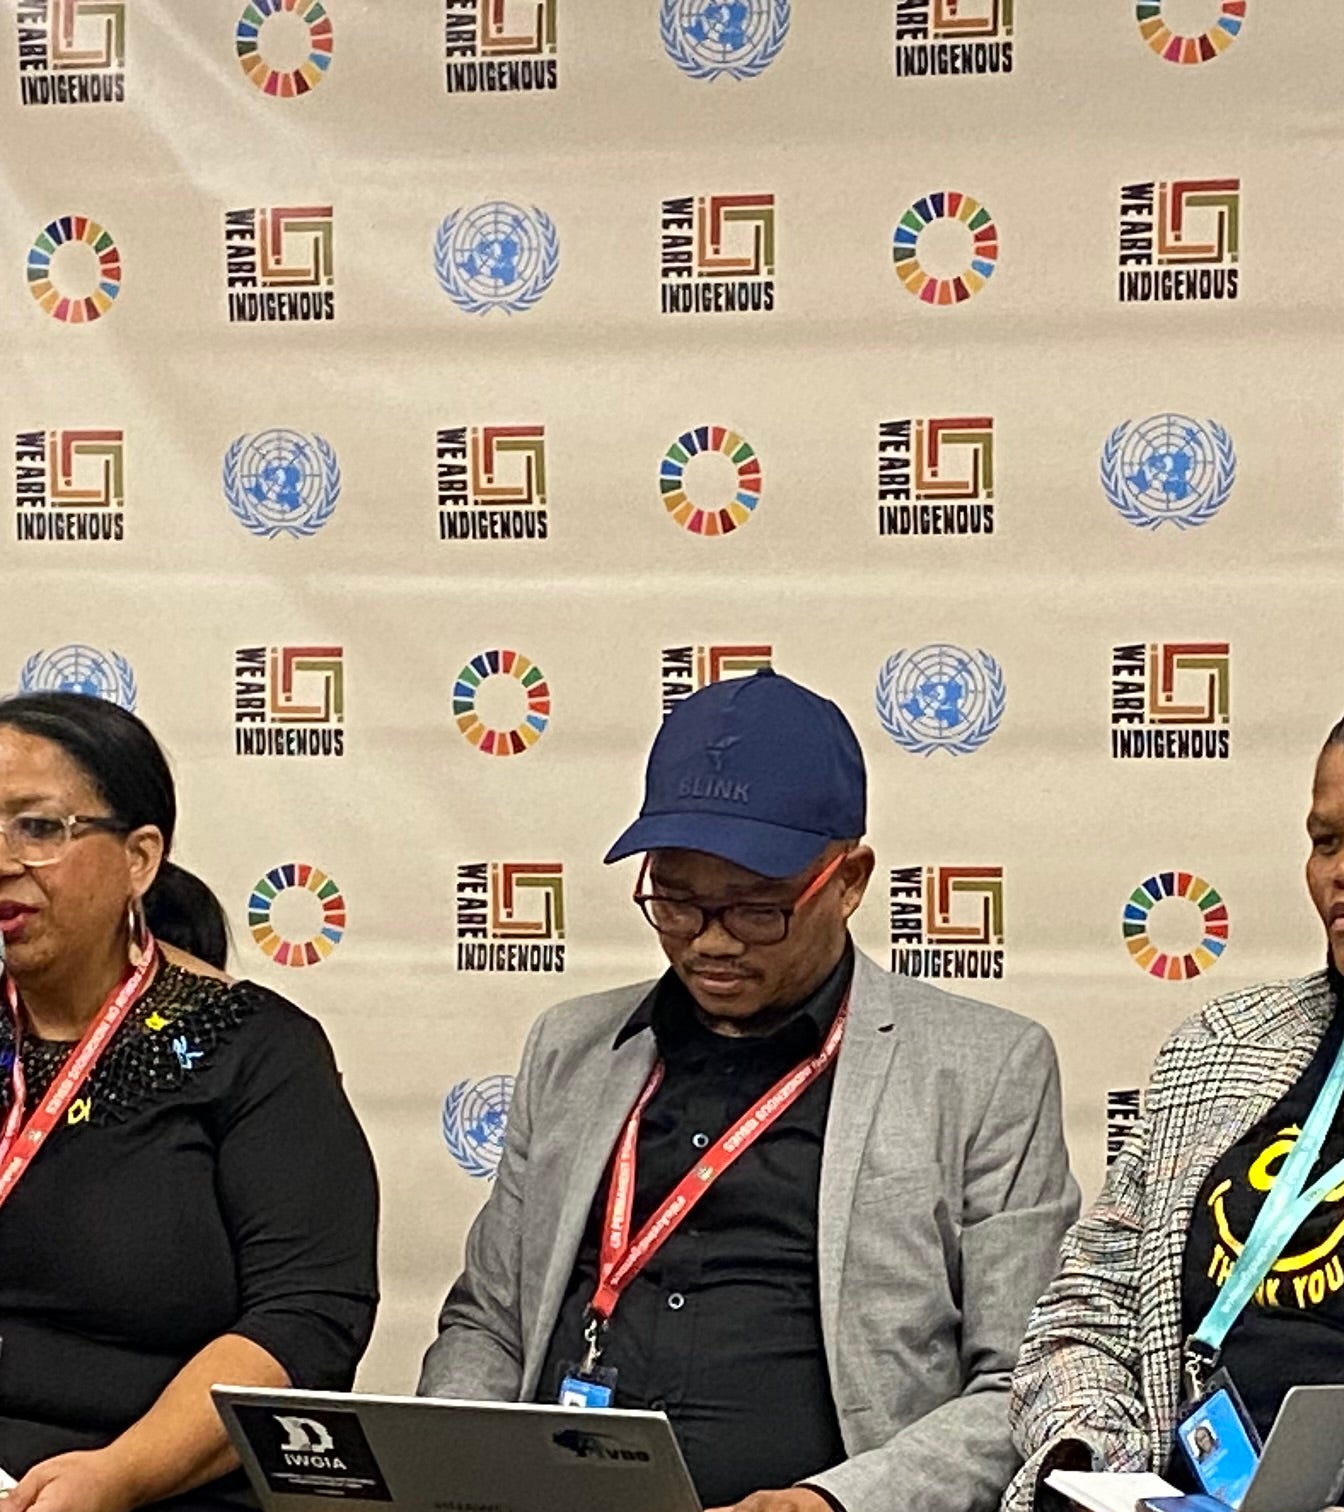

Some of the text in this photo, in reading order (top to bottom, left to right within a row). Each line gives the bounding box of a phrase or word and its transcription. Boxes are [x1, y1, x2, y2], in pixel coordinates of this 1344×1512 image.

[895, 41, 1013, 77] INDIGENOUS
[20, 74, 124, 106] INDIGENOUS
[446, 59, 557, 94] INDIGENOUS
[661, 281, 774, 314] INDIGENOUS
[1119, 268, 1239, 302] INDIGENOUS
[228, 291, 335, 322] INDIGENOUS
[16, 512, 124, 541] INDIGENOUS
[439, 509, 548, 540] INDIGENOUS
[878, 504, 994, 536] INDIGENOUS
[235, 727, 344, 757] INDIGENOUS
[1111, 729, 1230, 759] INDIGENOUS
[679, 778, 750, 803] BLINK
[457, 942, 566, 973] INDIGENOUS
[891, 948, 1004, 980] INDIGENOUS
[1207, 1243, 1280, 1307] THNK
[1293, 1254, 1344, 1309] YOU
[284, 1453, 347, 1470] IWGIA
